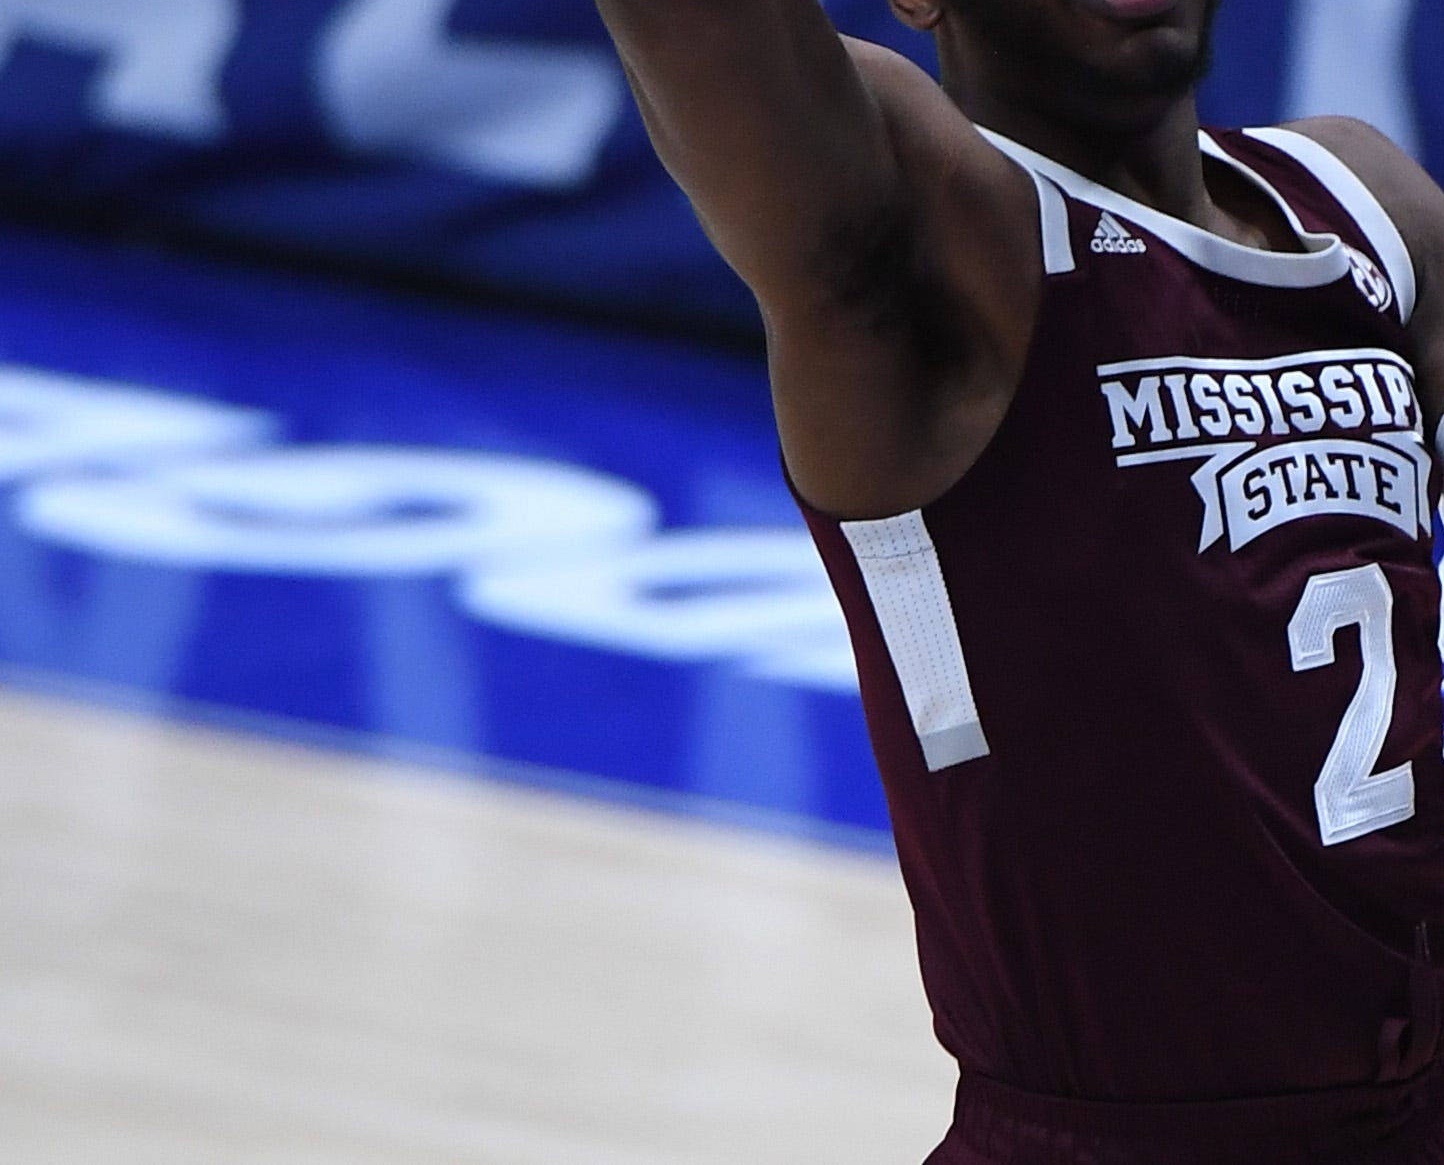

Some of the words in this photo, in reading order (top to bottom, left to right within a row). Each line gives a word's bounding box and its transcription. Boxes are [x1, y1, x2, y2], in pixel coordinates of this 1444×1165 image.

[1090, 238, 1147, 254] adidas
[1100, 362, 1423, 449] MISSISSIP
[1243, 453, 1402, 521] STATE
[1287, 562, 1415, 846] 2
